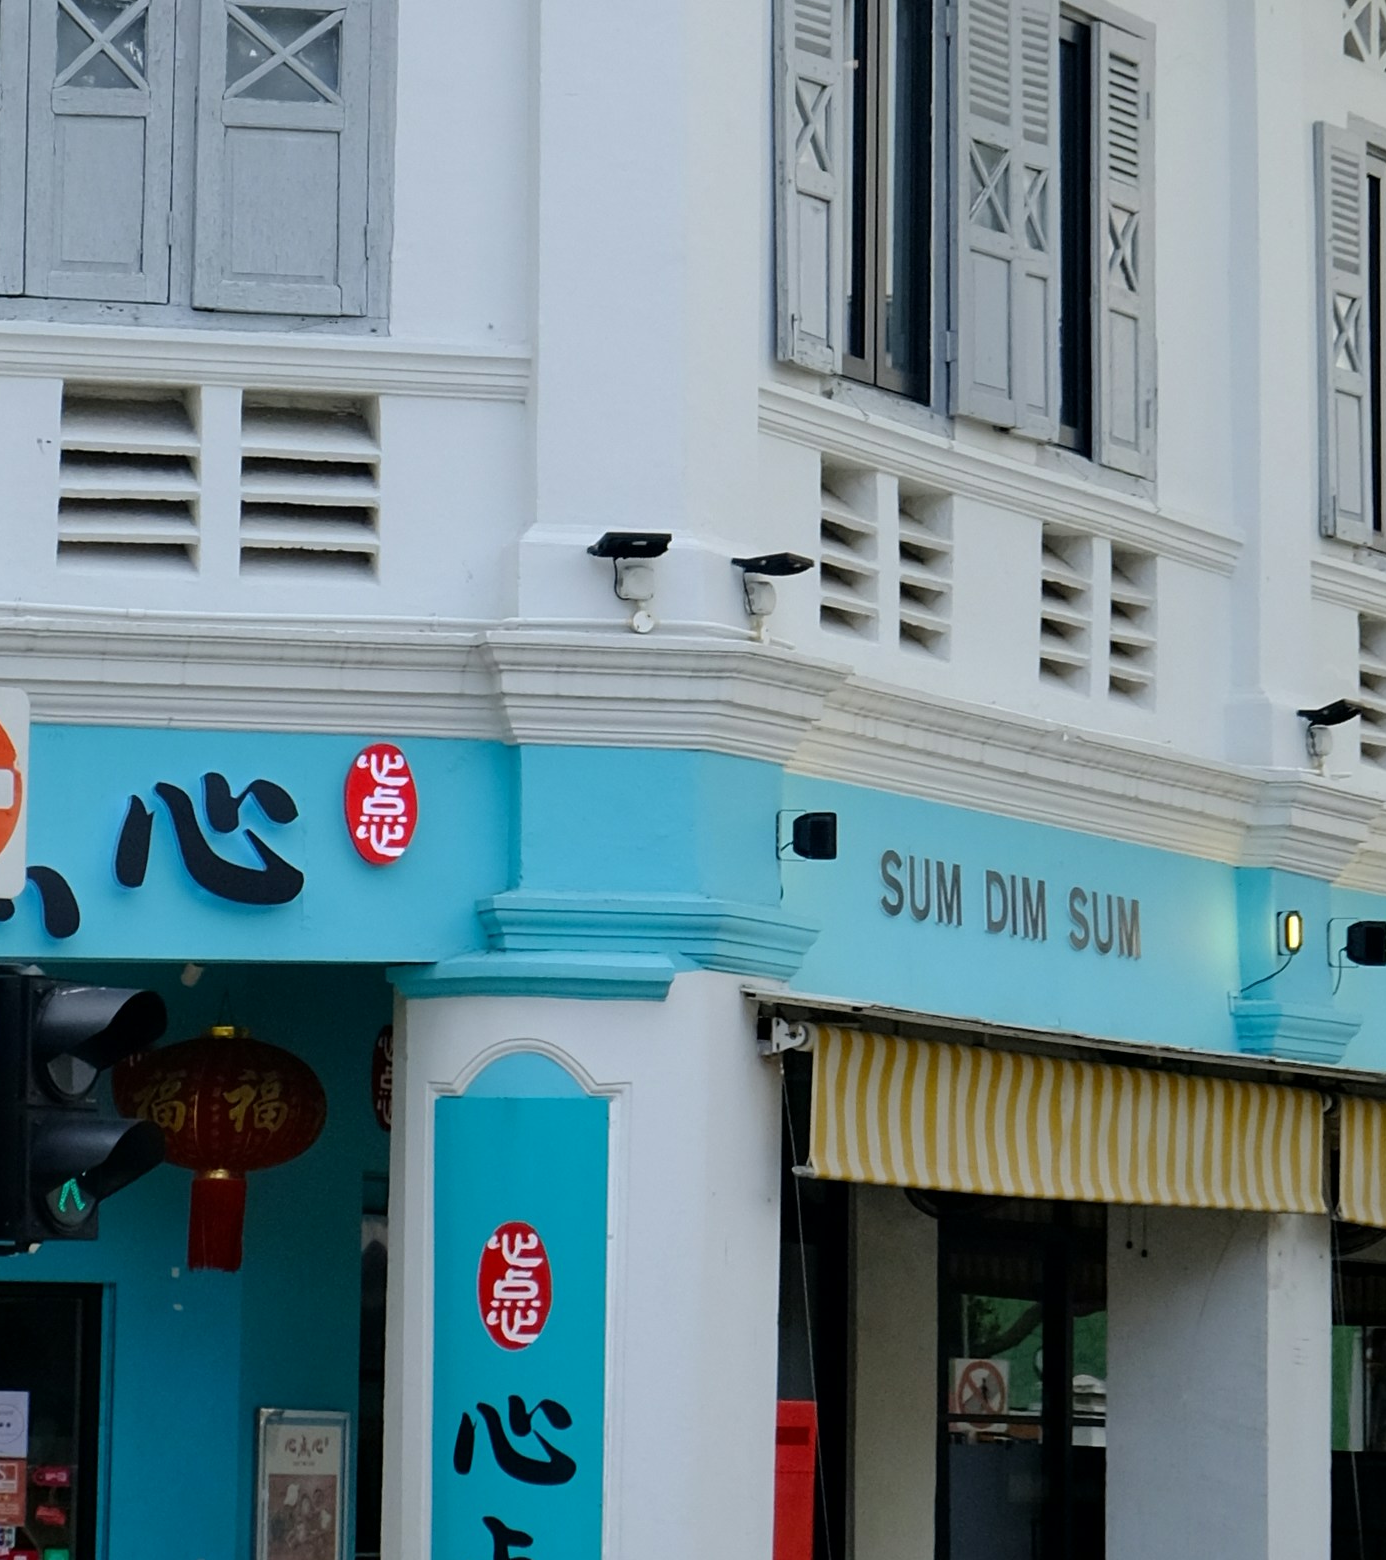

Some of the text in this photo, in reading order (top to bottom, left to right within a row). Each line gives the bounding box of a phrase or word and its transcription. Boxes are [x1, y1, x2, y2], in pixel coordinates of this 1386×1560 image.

[879, 849, 1141, 961] SUM DIM SUM
